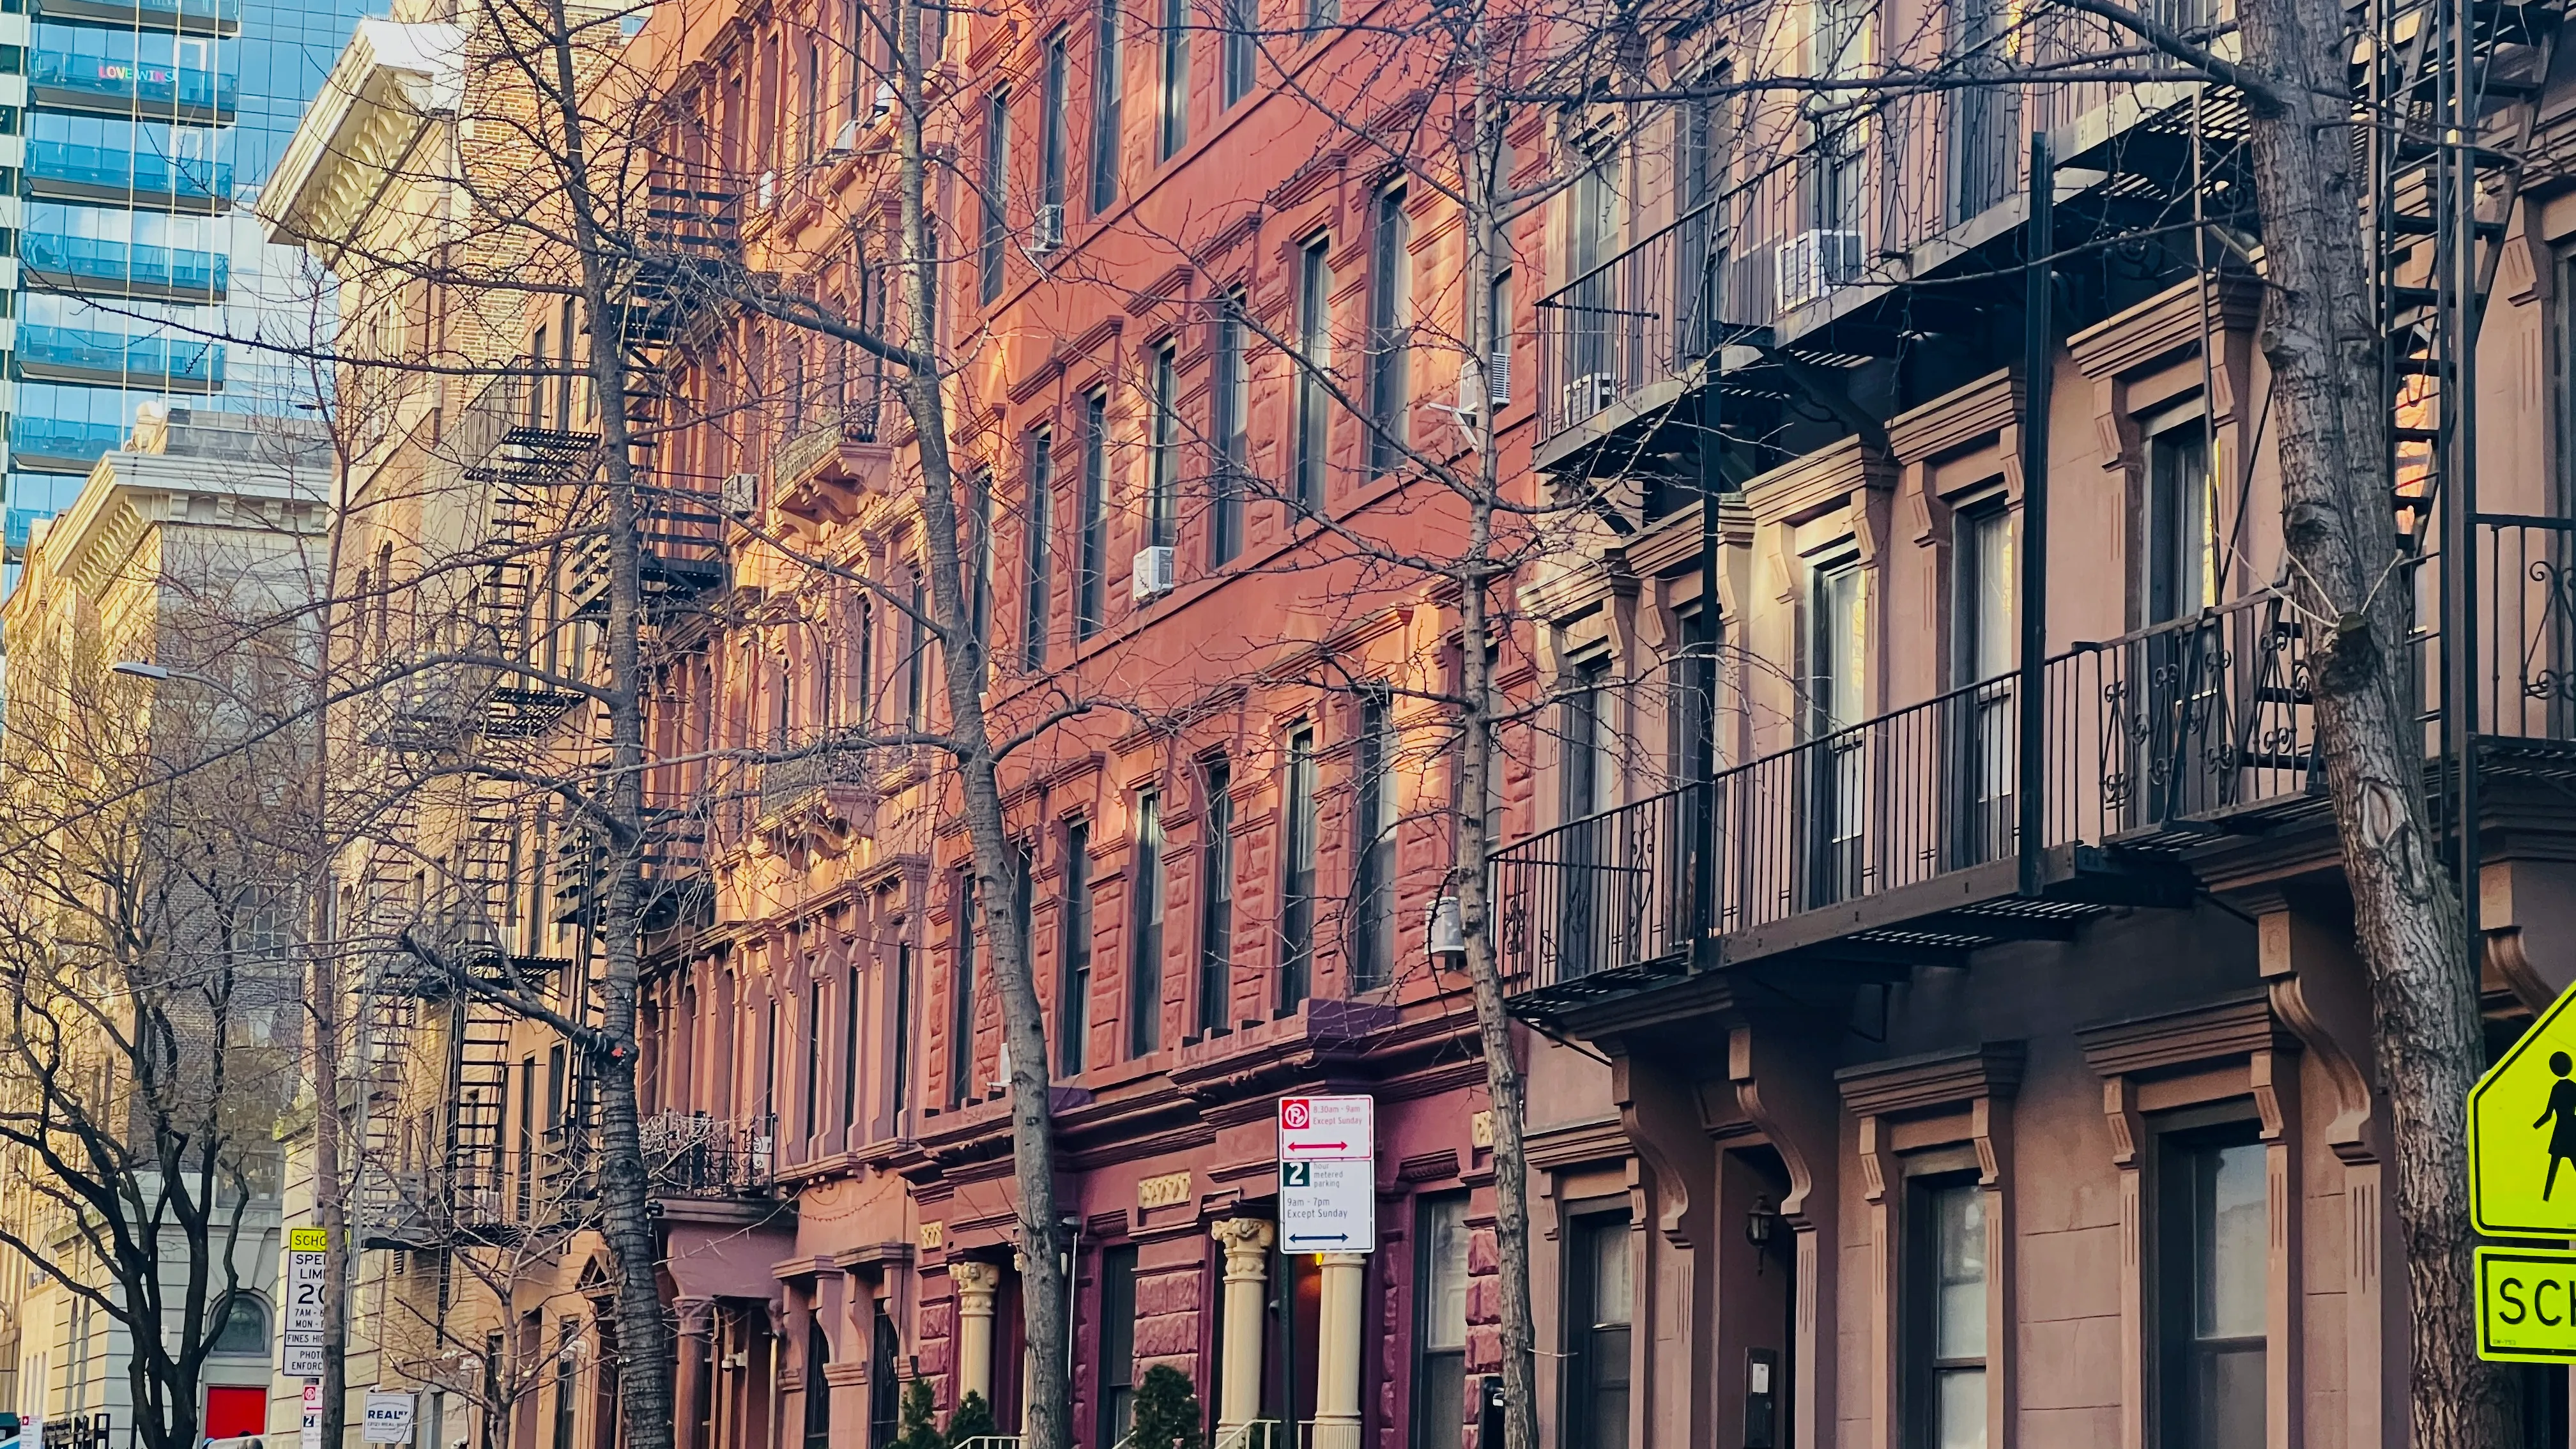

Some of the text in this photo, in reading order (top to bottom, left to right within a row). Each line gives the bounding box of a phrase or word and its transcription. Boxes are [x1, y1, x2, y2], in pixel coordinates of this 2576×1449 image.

[98, 66, 174, 82] LOVE WINS
[1314, 1117, 1336, 1125] Except
[1289, 1162, 1304, 1185] 2
[1314, 1180, 1340, 1188] parking
[1287, 1198, 1304, 1206] 9am
[1314, 1197, 1330, 1207] 7pm
[1287, 1209, 1347, 1218] Except Sunday
[295, 1236, 326, 1246] SCHO
[295, 1308, 311, 1317] 7AM
[288, 1334, 309, 1342] FINES
[300, 1351, 323, 1360] PHOT
[291, 1361, 322, 1370] ENFORC
